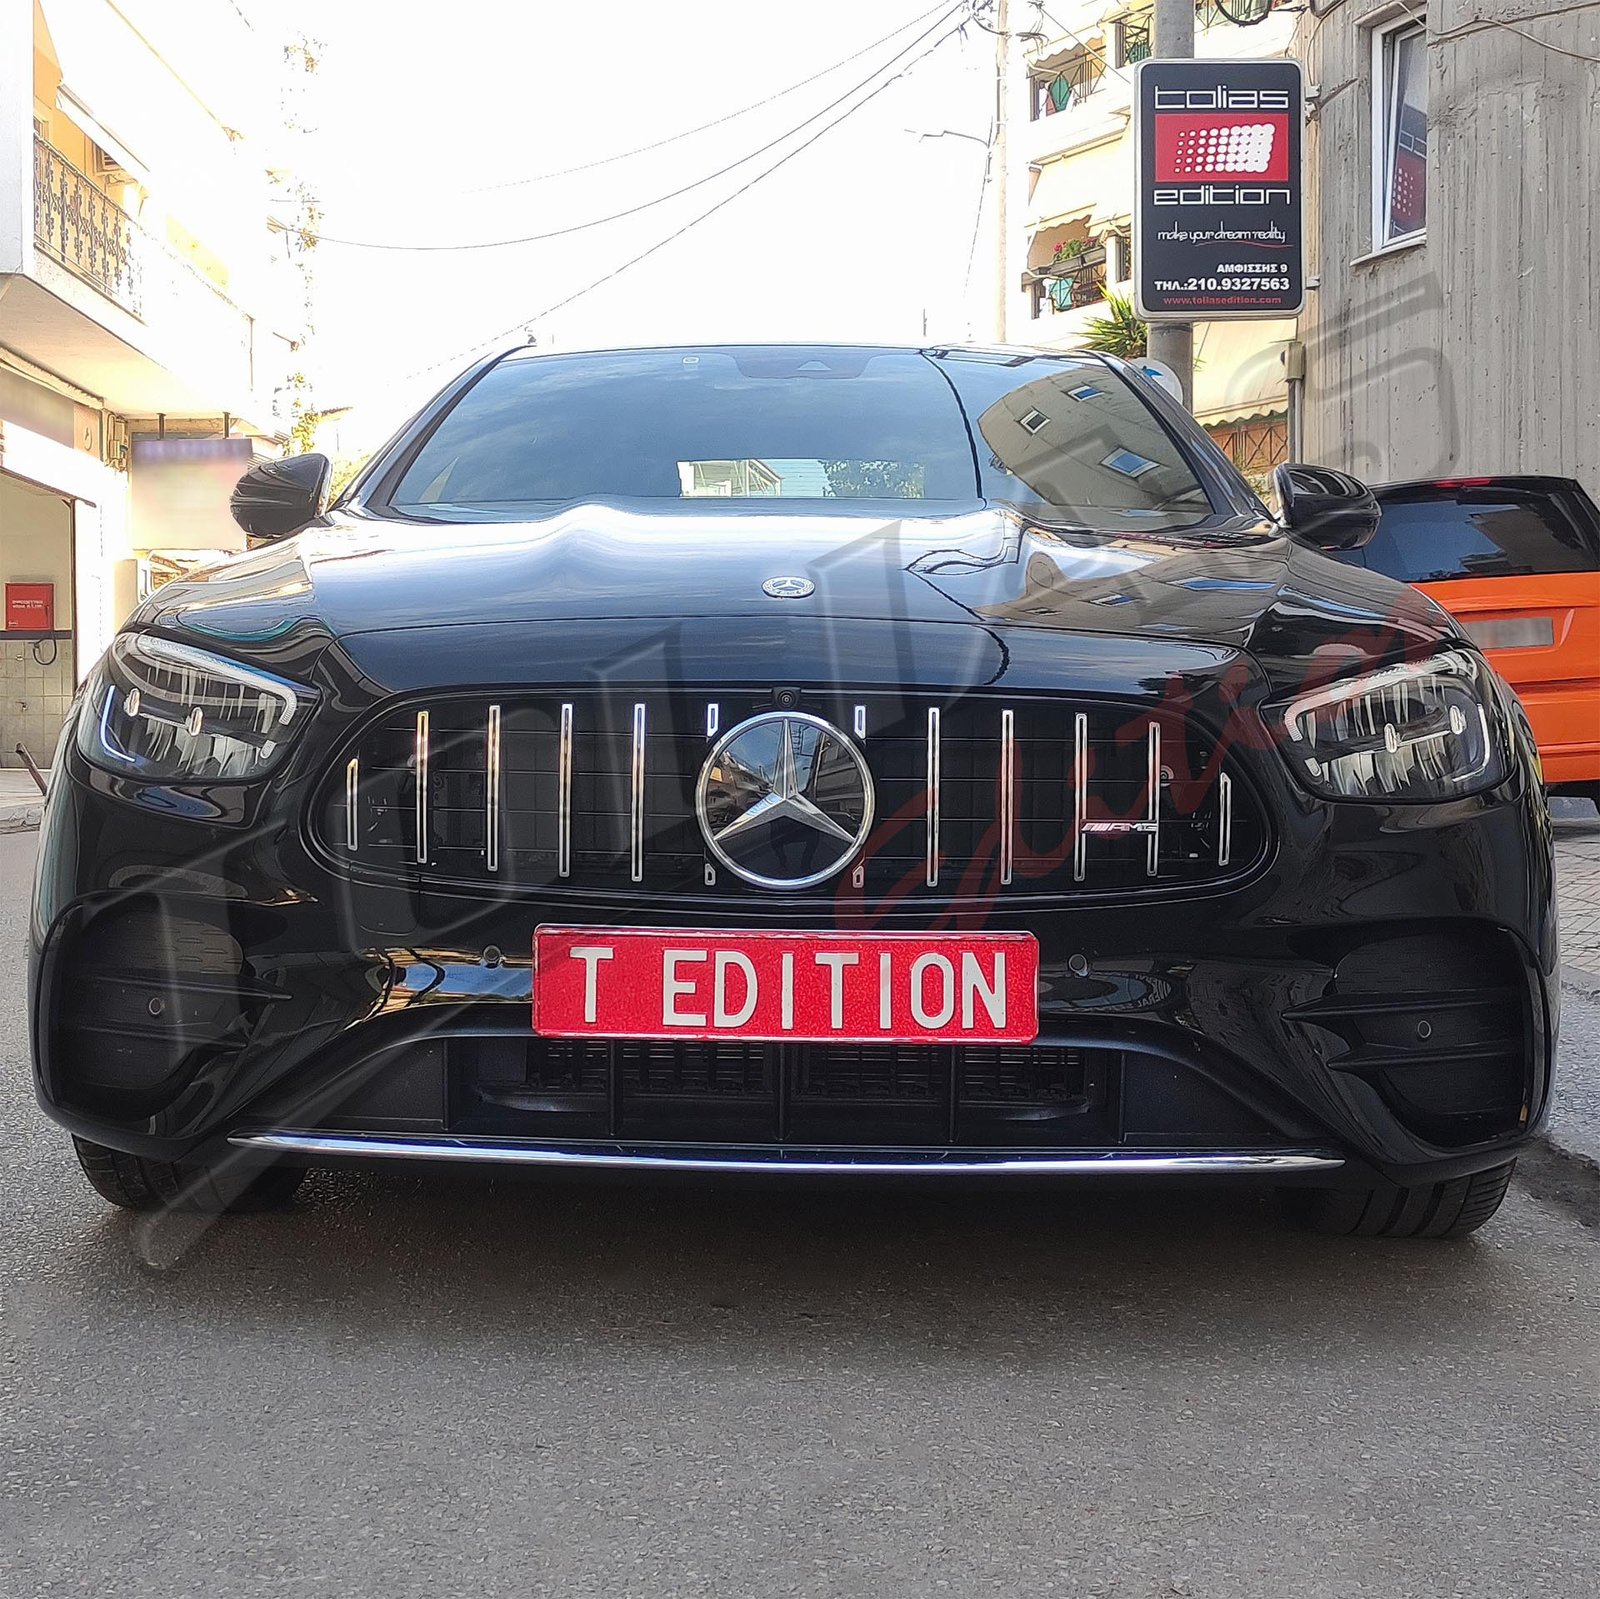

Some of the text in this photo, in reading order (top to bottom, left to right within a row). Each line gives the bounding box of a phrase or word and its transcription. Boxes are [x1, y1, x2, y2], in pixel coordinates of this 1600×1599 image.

[1155, 85, 1289, 109] tolias
[1154, 185, 1291, 205] edition
[1157, 221, 1286, 243] make your dream reality
[1280, 264, 1288, 273] 9
[568, 946, 1006, 1031] T EDITION
